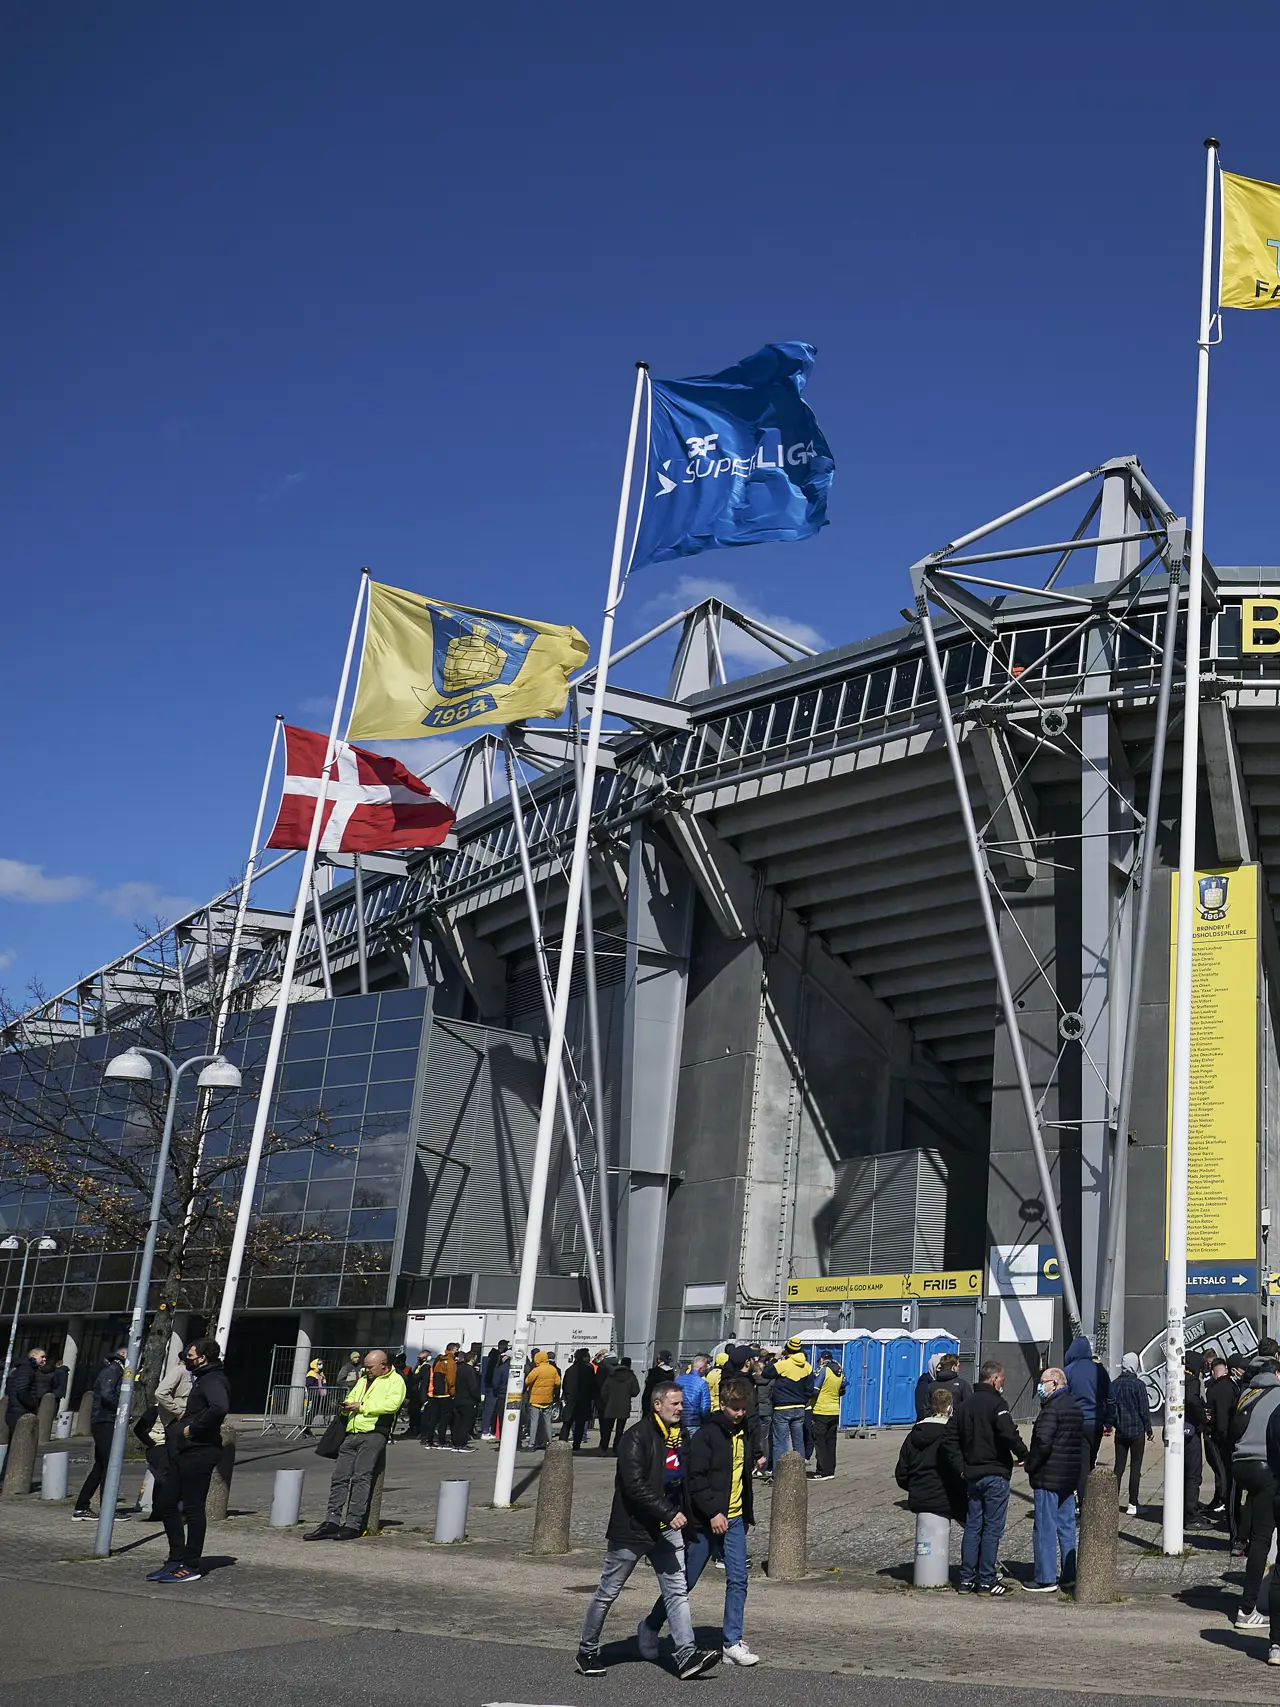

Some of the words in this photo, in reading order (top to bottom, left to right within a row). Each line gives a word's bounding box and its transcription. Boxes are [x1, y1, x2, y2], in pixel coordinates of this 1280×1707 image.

[686, 433, 719, 458] 3F
[433, 698, 488, 726] 1964
[1204, 912, 1224, 920] 1964
[1193, 930, 1247, 938] DSHOLDSSPILLERE
[1043, 1258, 1060, 1280] C
[923, 1279, 957, 1291] FRIIS
[969, 1274, 977, 1288] C
[1186, 1276, 1226, 1285] LETSALG
[816, 1285, 848, 1293] VELKOMMEN
[868, 1283, 883, 1291] KAMP
